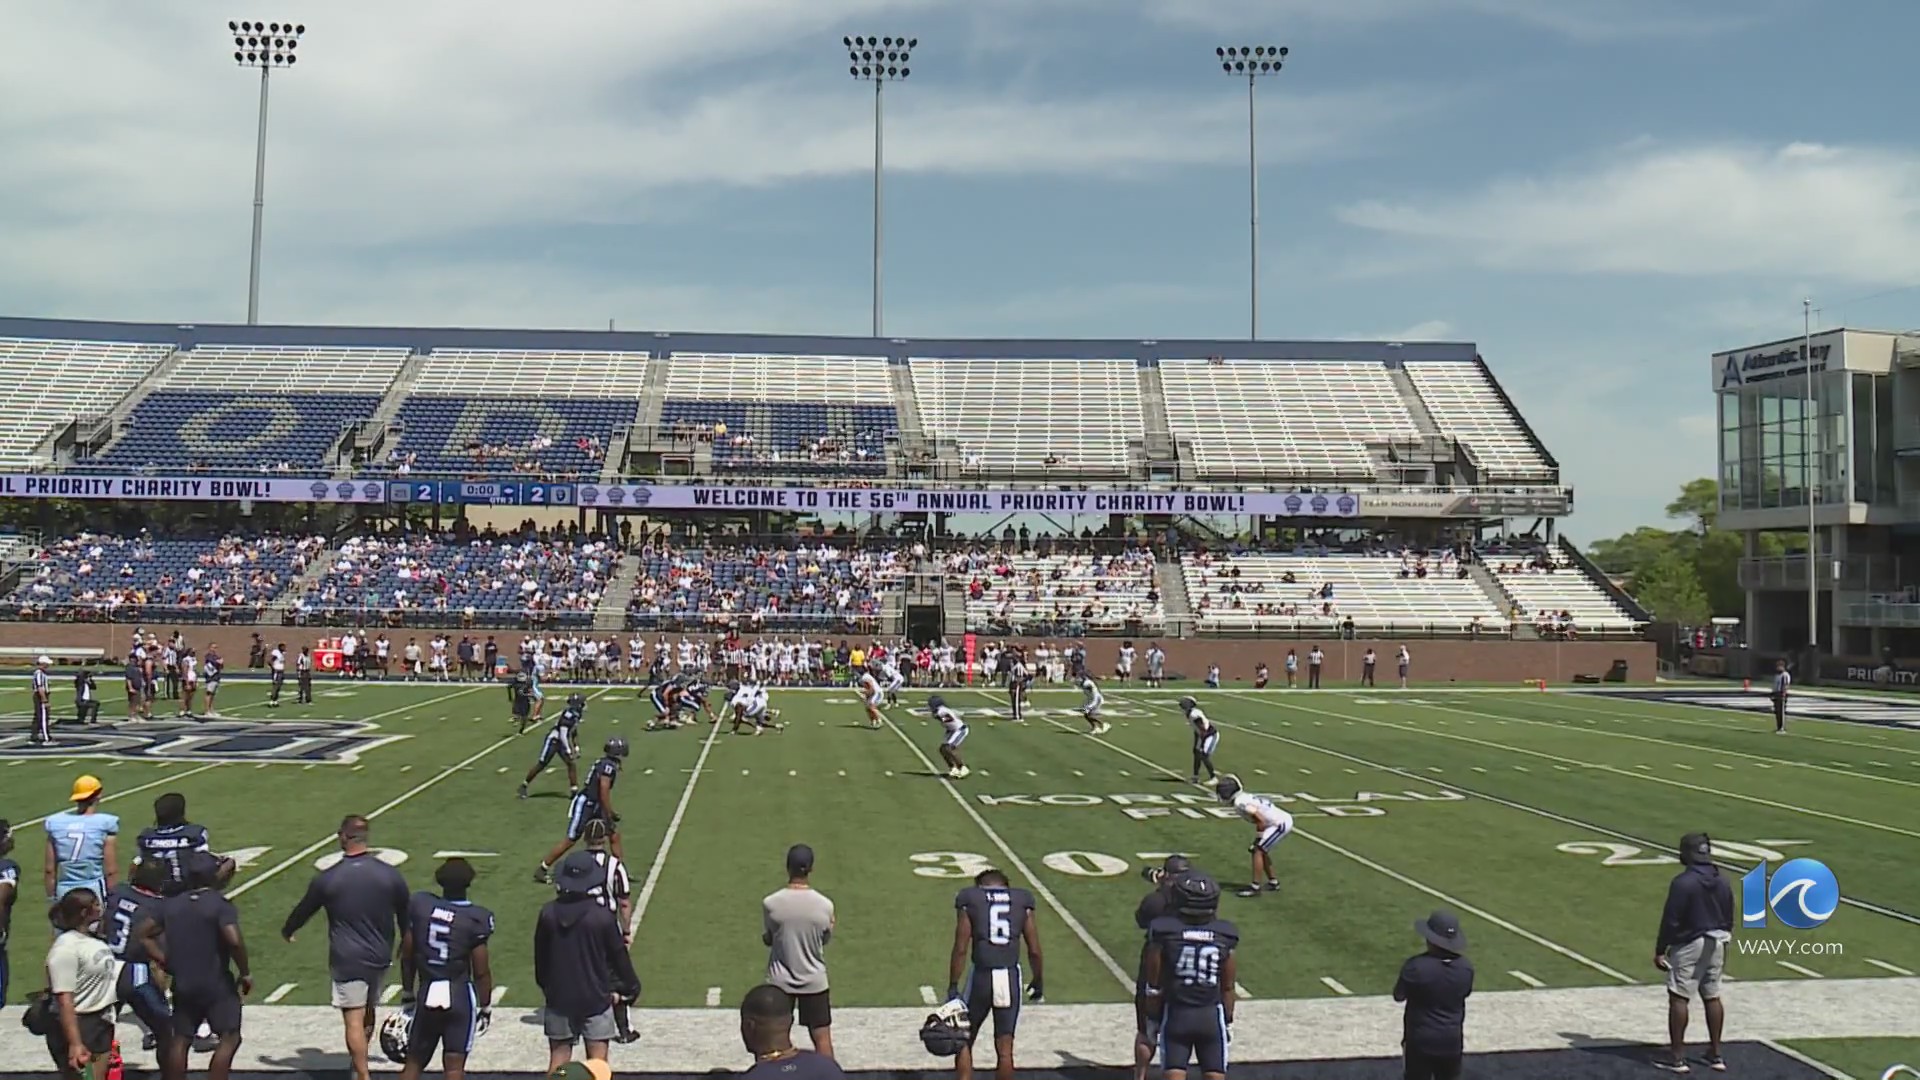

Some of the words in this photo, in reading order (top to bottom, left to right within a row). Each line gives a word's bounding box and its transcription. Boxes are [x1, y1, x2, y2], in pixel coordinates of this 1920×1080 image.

[1742, 350, 1799, 372] Atlantic
[25, 478, 114, 495] PRIORITY
[121, 479, 202, 496] CHARITY
[210, 480, 272, 498] BOWL!
[418, 485, 432, 501] 2
[467, 485, 495, 496] 0:00
[531, 487, 545, 502] 2
[693, 489, 788, 507] WELCOME
[796, 491, 818, 507] TO
[826, 491, 862, 508] THE
[870, 492, 909, 509] 56TH
[917, 493, 992, 510] ANNUAL
[1001, 494, 1088, 511] PRIORITY
[1096, 494, 1177, 512] CHARITY
[1184, 495, 1246, 513] BOWL!
[322, 653, 335, 668] G
[67, 832, 86, 863] 7
[989, 904, 1010, 945] 6
[427, 923, 451, 966] 5
[1175, 945, 1219, 987] 40
